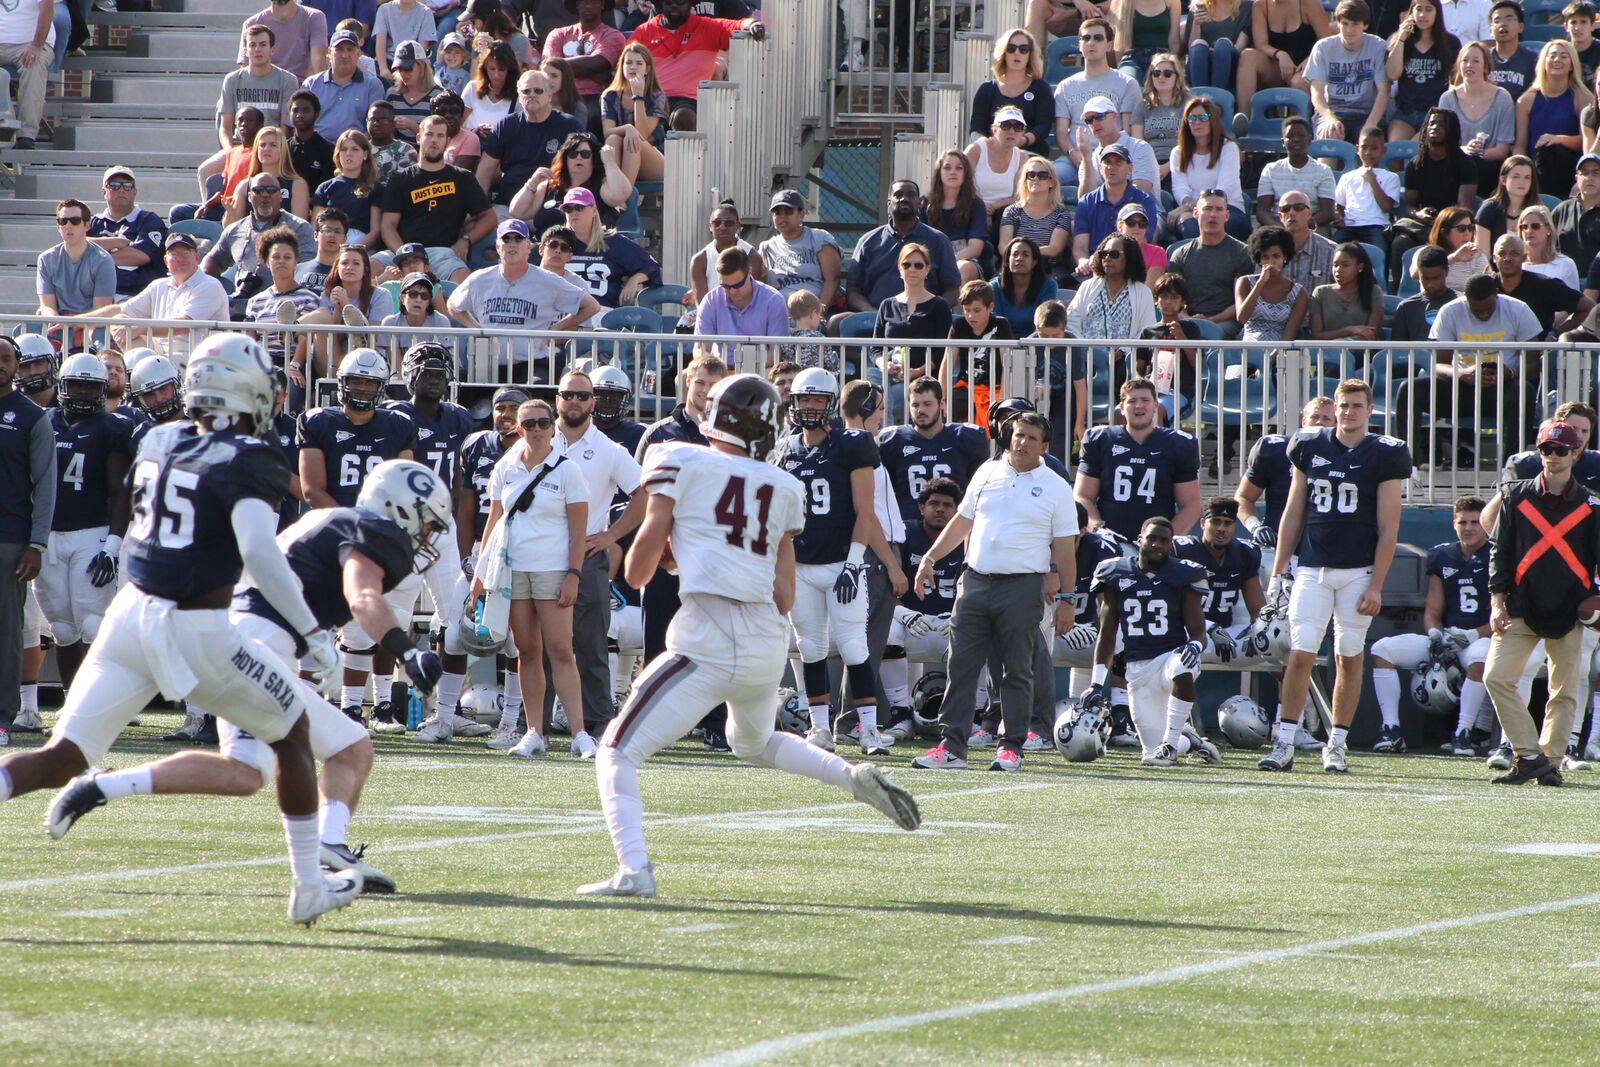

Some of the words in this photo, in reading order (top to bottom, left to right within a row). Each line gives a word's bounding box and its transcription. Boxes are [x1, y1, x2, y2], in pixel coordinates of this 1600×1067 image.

[235, 88, 281, 104] GEORGETOWN
[1335, 81, 1363, 96] 2017
[414, 188, 433, 201] JUST
[432, 185, 443, 196] DO
[443, 183, 454, 193] IT.
[428, 199, 437, 213] P
[482, 297, 539, 321] GEORGETOWN
[62, 452, 86, 491] 4
[407, 470, 436, 501] G
[426, 450, 456, 490] 71
[1113, 465, 1157, 504] 64
[1308, 477, 1359, 514] 80
[714, 474, 774, 558] 41
[1459, 585, 1479, 613] 6
[1123, 598, 1169, 637] 23
[231, 647, 262, 682] HOYA
[264, 671, 295, 713] SAXA
